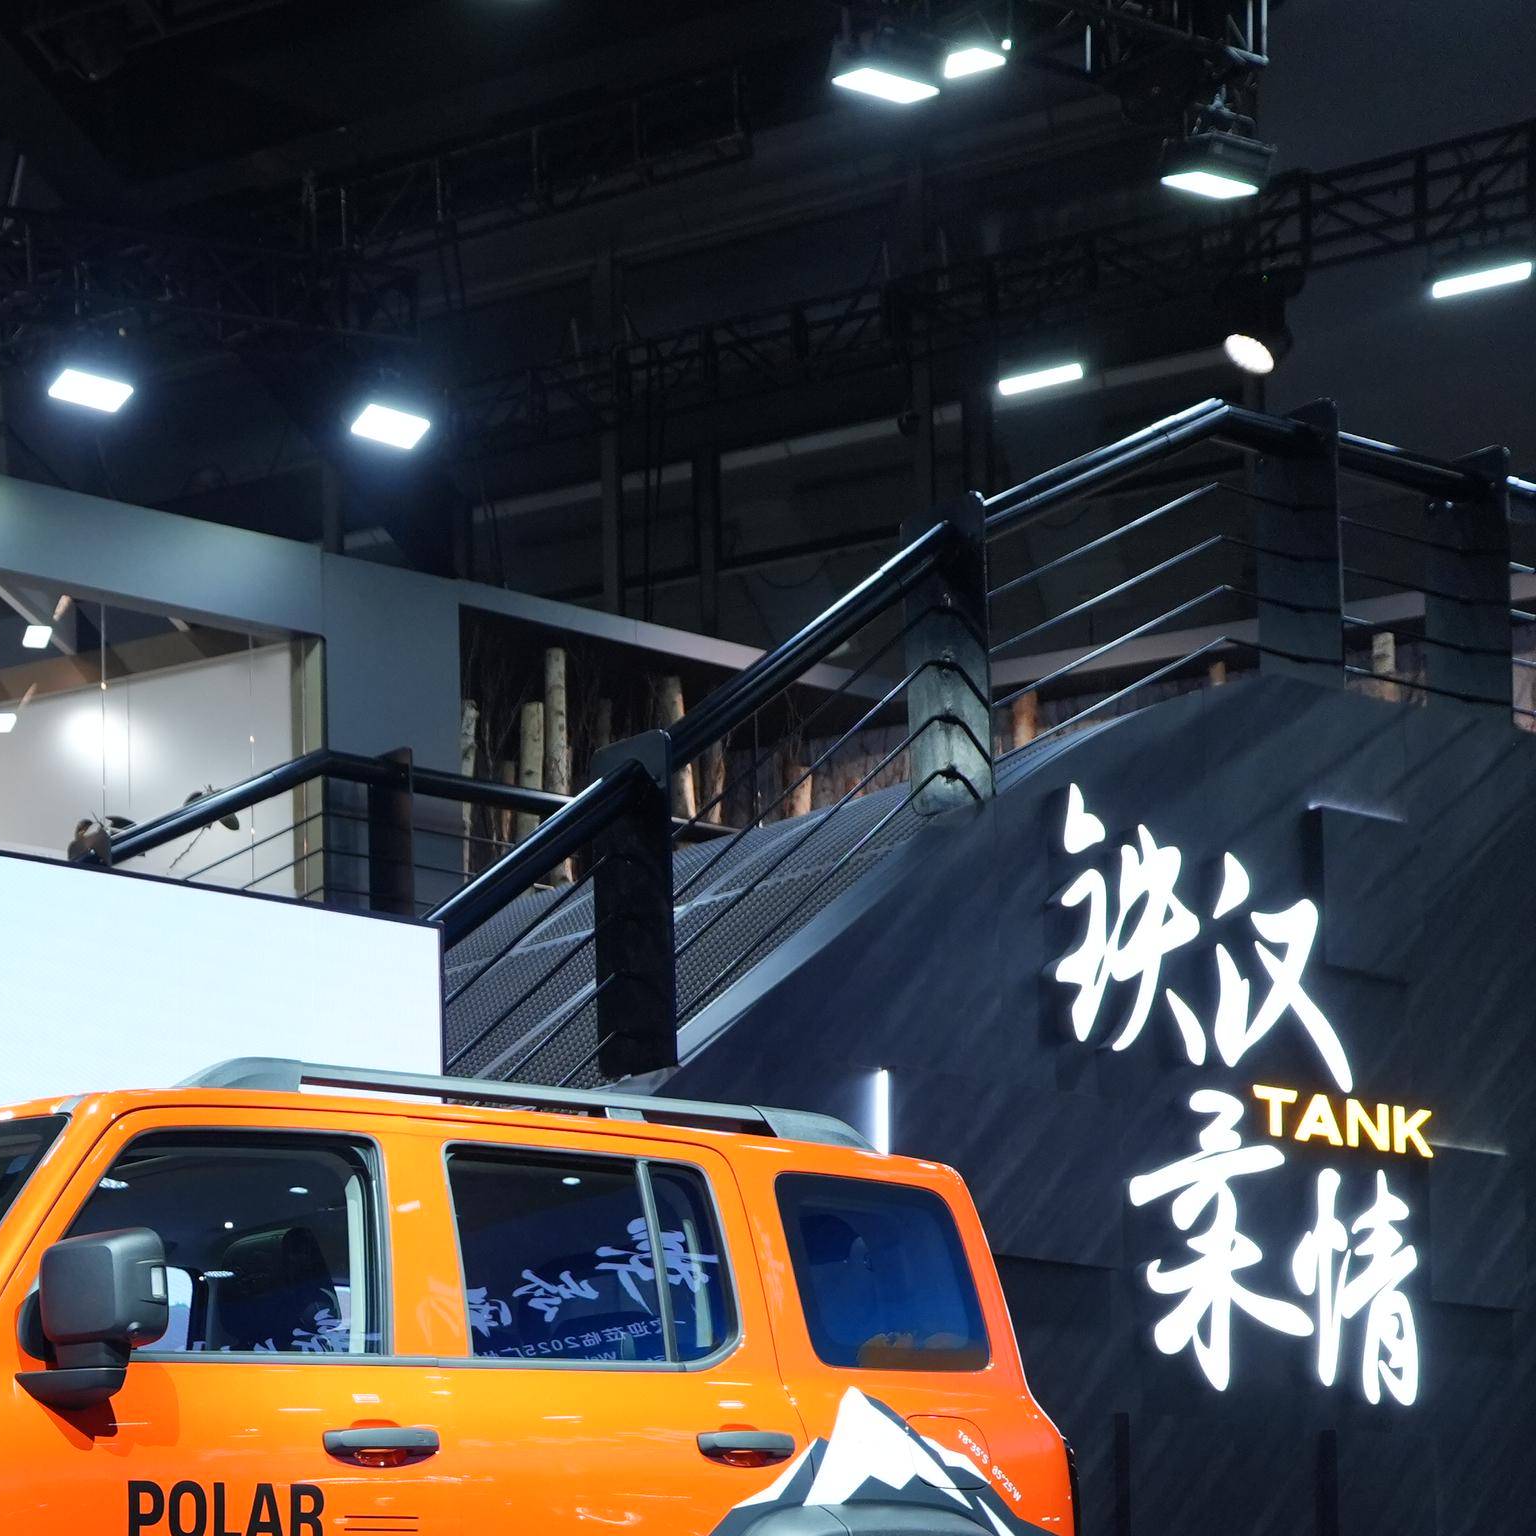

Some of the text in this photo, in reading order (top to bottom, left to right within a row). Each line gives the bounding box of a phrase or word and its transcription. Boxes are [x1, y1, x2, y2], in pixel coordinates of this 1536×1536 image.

[1054, 781, 1353, 1092] 铁汉
[1252, 1083, 1434, 1159] TANK
[1128, 1088, 1420, 1407] 柔情
[957, 1429, 1022, 1502] 78°35'S 85°25'W
